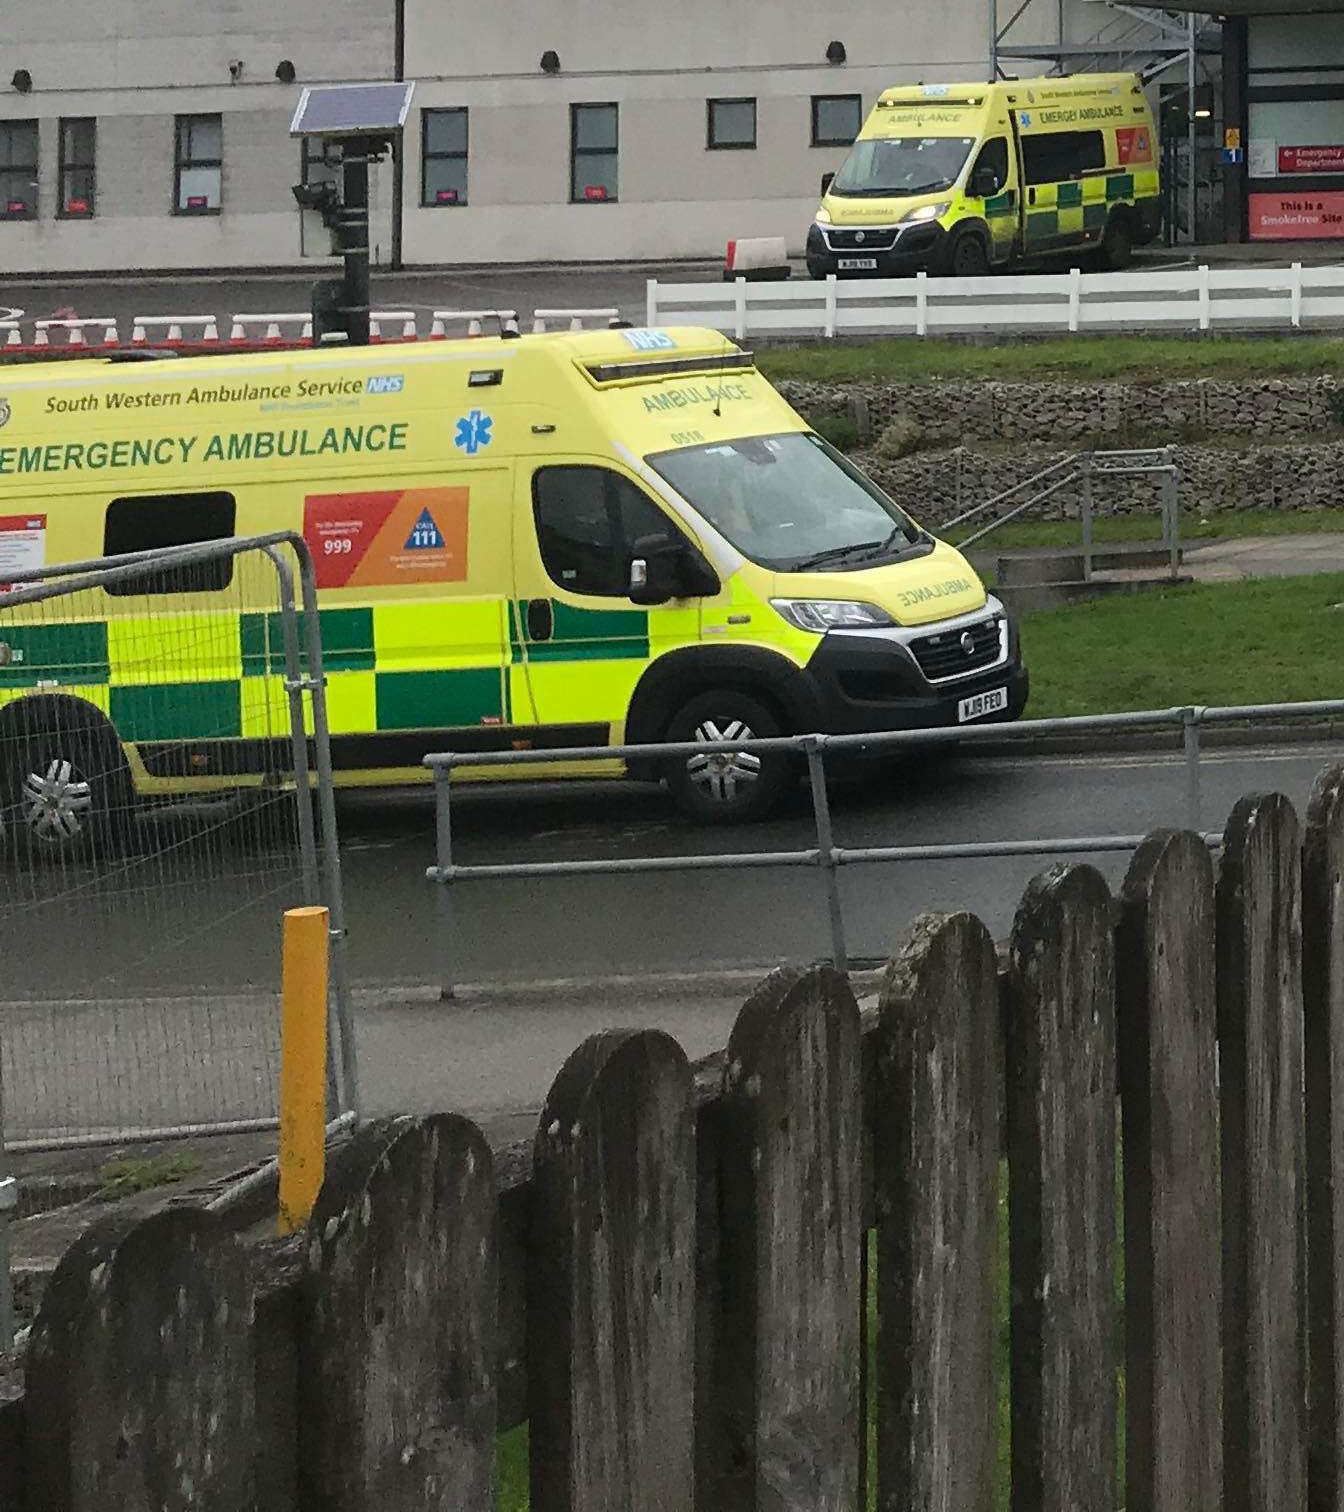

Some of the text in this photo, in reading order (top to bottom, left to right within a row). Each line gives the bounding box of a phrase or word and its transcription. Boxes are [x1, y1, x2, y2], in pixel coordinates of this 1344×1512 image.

[888, 113, 962, 124] AMBULANCE
[1296, 147, 1341, 159] Emergency
[1281, 201, 1301, 211] This
[1304, 201, 1314, 211] is
[1261, 213, 1343, 226] Smokefree Site
[623, 330, 674, 350] NHS
[44, 376, 403, 414] South Western Ambulance Service NHS
[642, 385, 752, 412] AMBULANCE
[0, 423, 409, 474] EMERGENCY AMBULANCE
[412, 531, 436, 545] 111
[324, 539, 351, 555] 999
